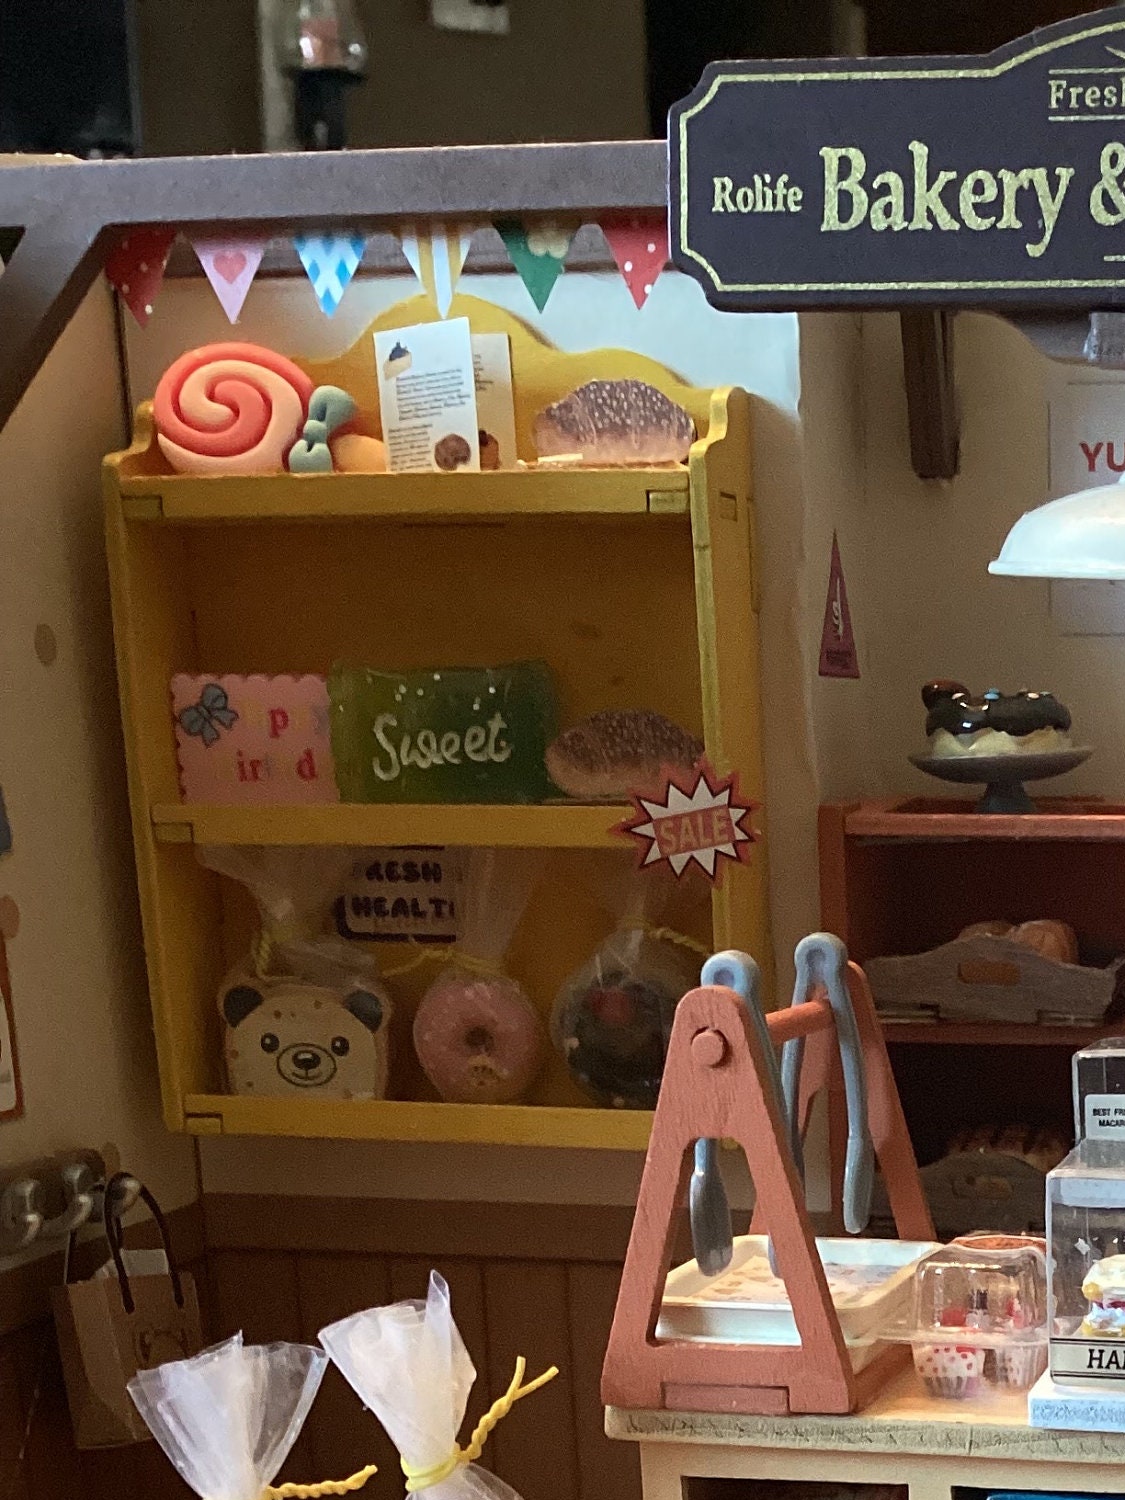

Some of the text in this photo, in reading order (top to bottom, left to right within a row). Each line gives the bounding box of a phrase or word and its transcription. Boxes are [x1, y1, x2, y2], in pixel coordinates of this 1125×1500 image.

[711, 173, 803, 213] Rolife
[818, 140, 1075, 258] Bakery
[372, 712, 512, 782] Sweet
[659, 808, 730, 855] SALE
